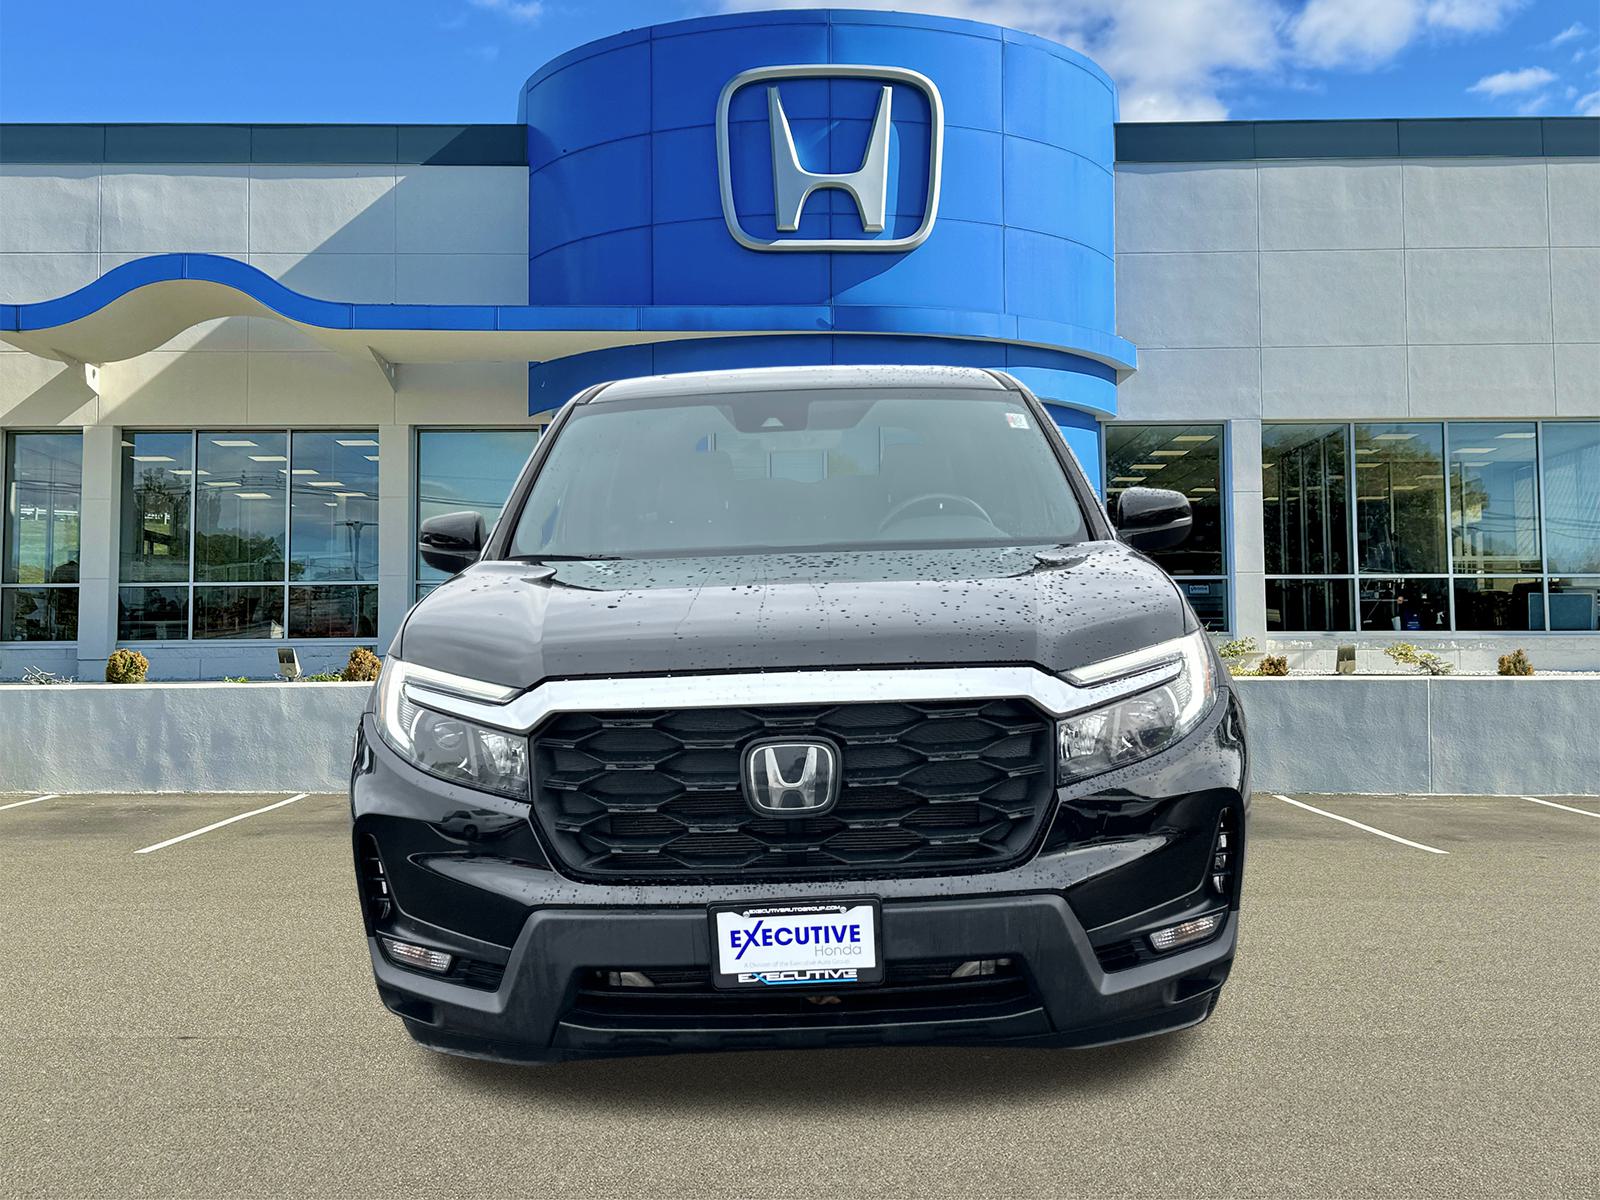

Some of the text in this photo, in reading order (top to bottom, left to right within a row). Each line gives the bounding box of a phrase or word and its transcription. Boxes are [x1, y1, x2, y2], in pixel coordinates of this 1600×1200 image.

[730, 919, 861, 960] EXECUTIVE
[815, 944, 862, 957] Honda
[738, 969, 858, 985] EXECUTIVE
